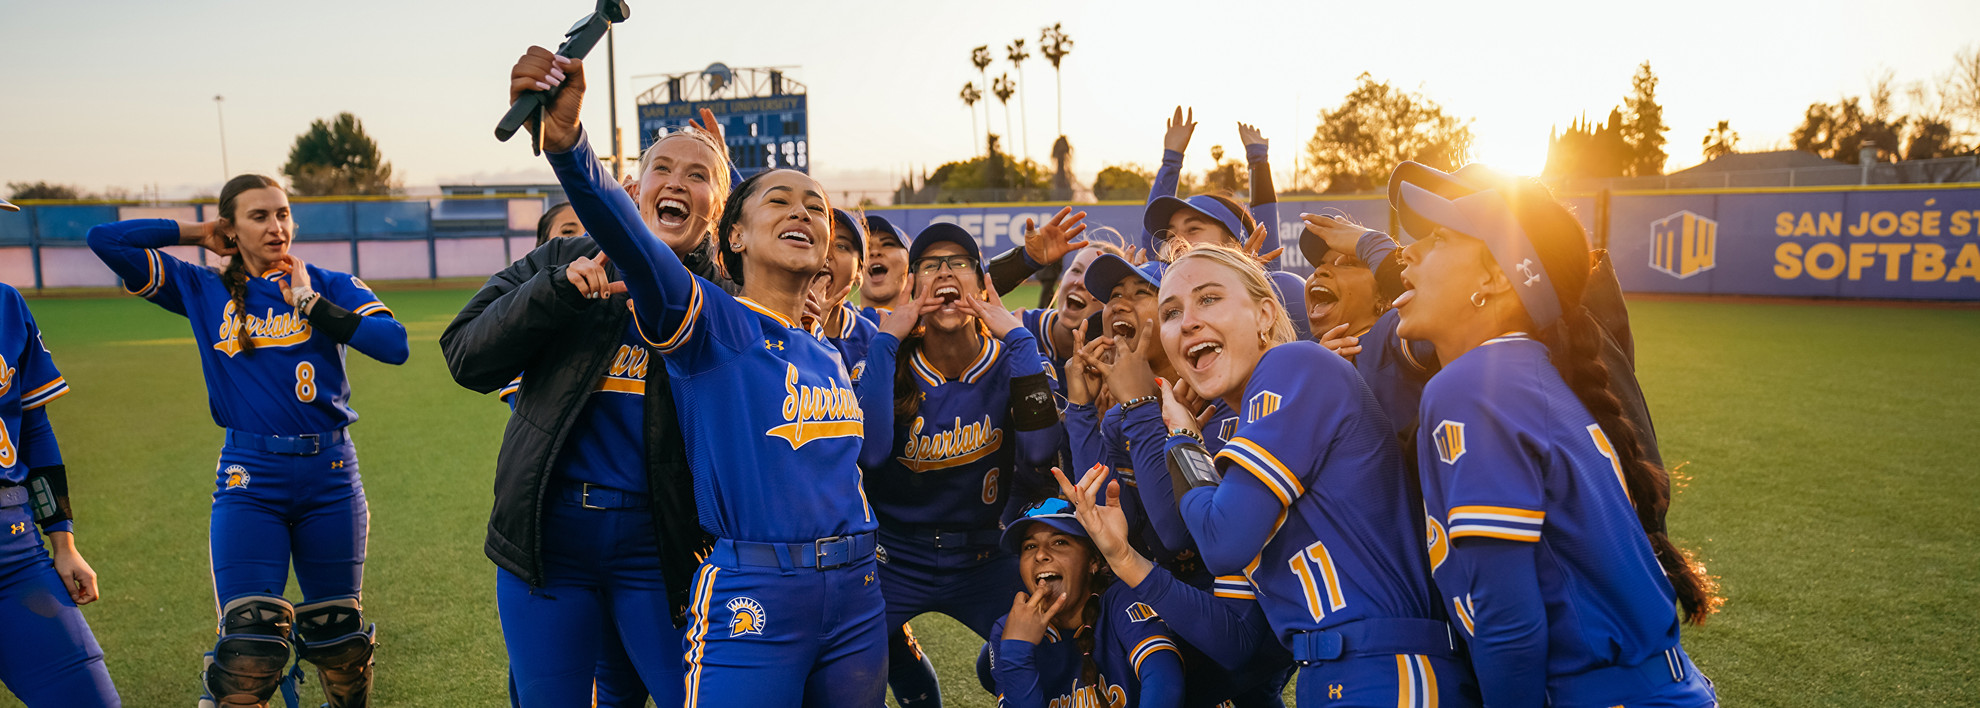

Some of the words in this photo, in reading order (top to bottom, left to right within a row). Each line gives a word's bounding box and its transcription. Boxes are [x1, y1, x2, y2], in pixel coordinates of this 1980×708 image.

[1775, 211, 1842, 236] SAN
[1848, 198, 1942, 237] JOSÉ
[295, 361, 316, 402] 8
[905, 414, 996, 468] Spartans
[982, 467, 999, 504] 6
[1288, 540, 1347, 624] 11
